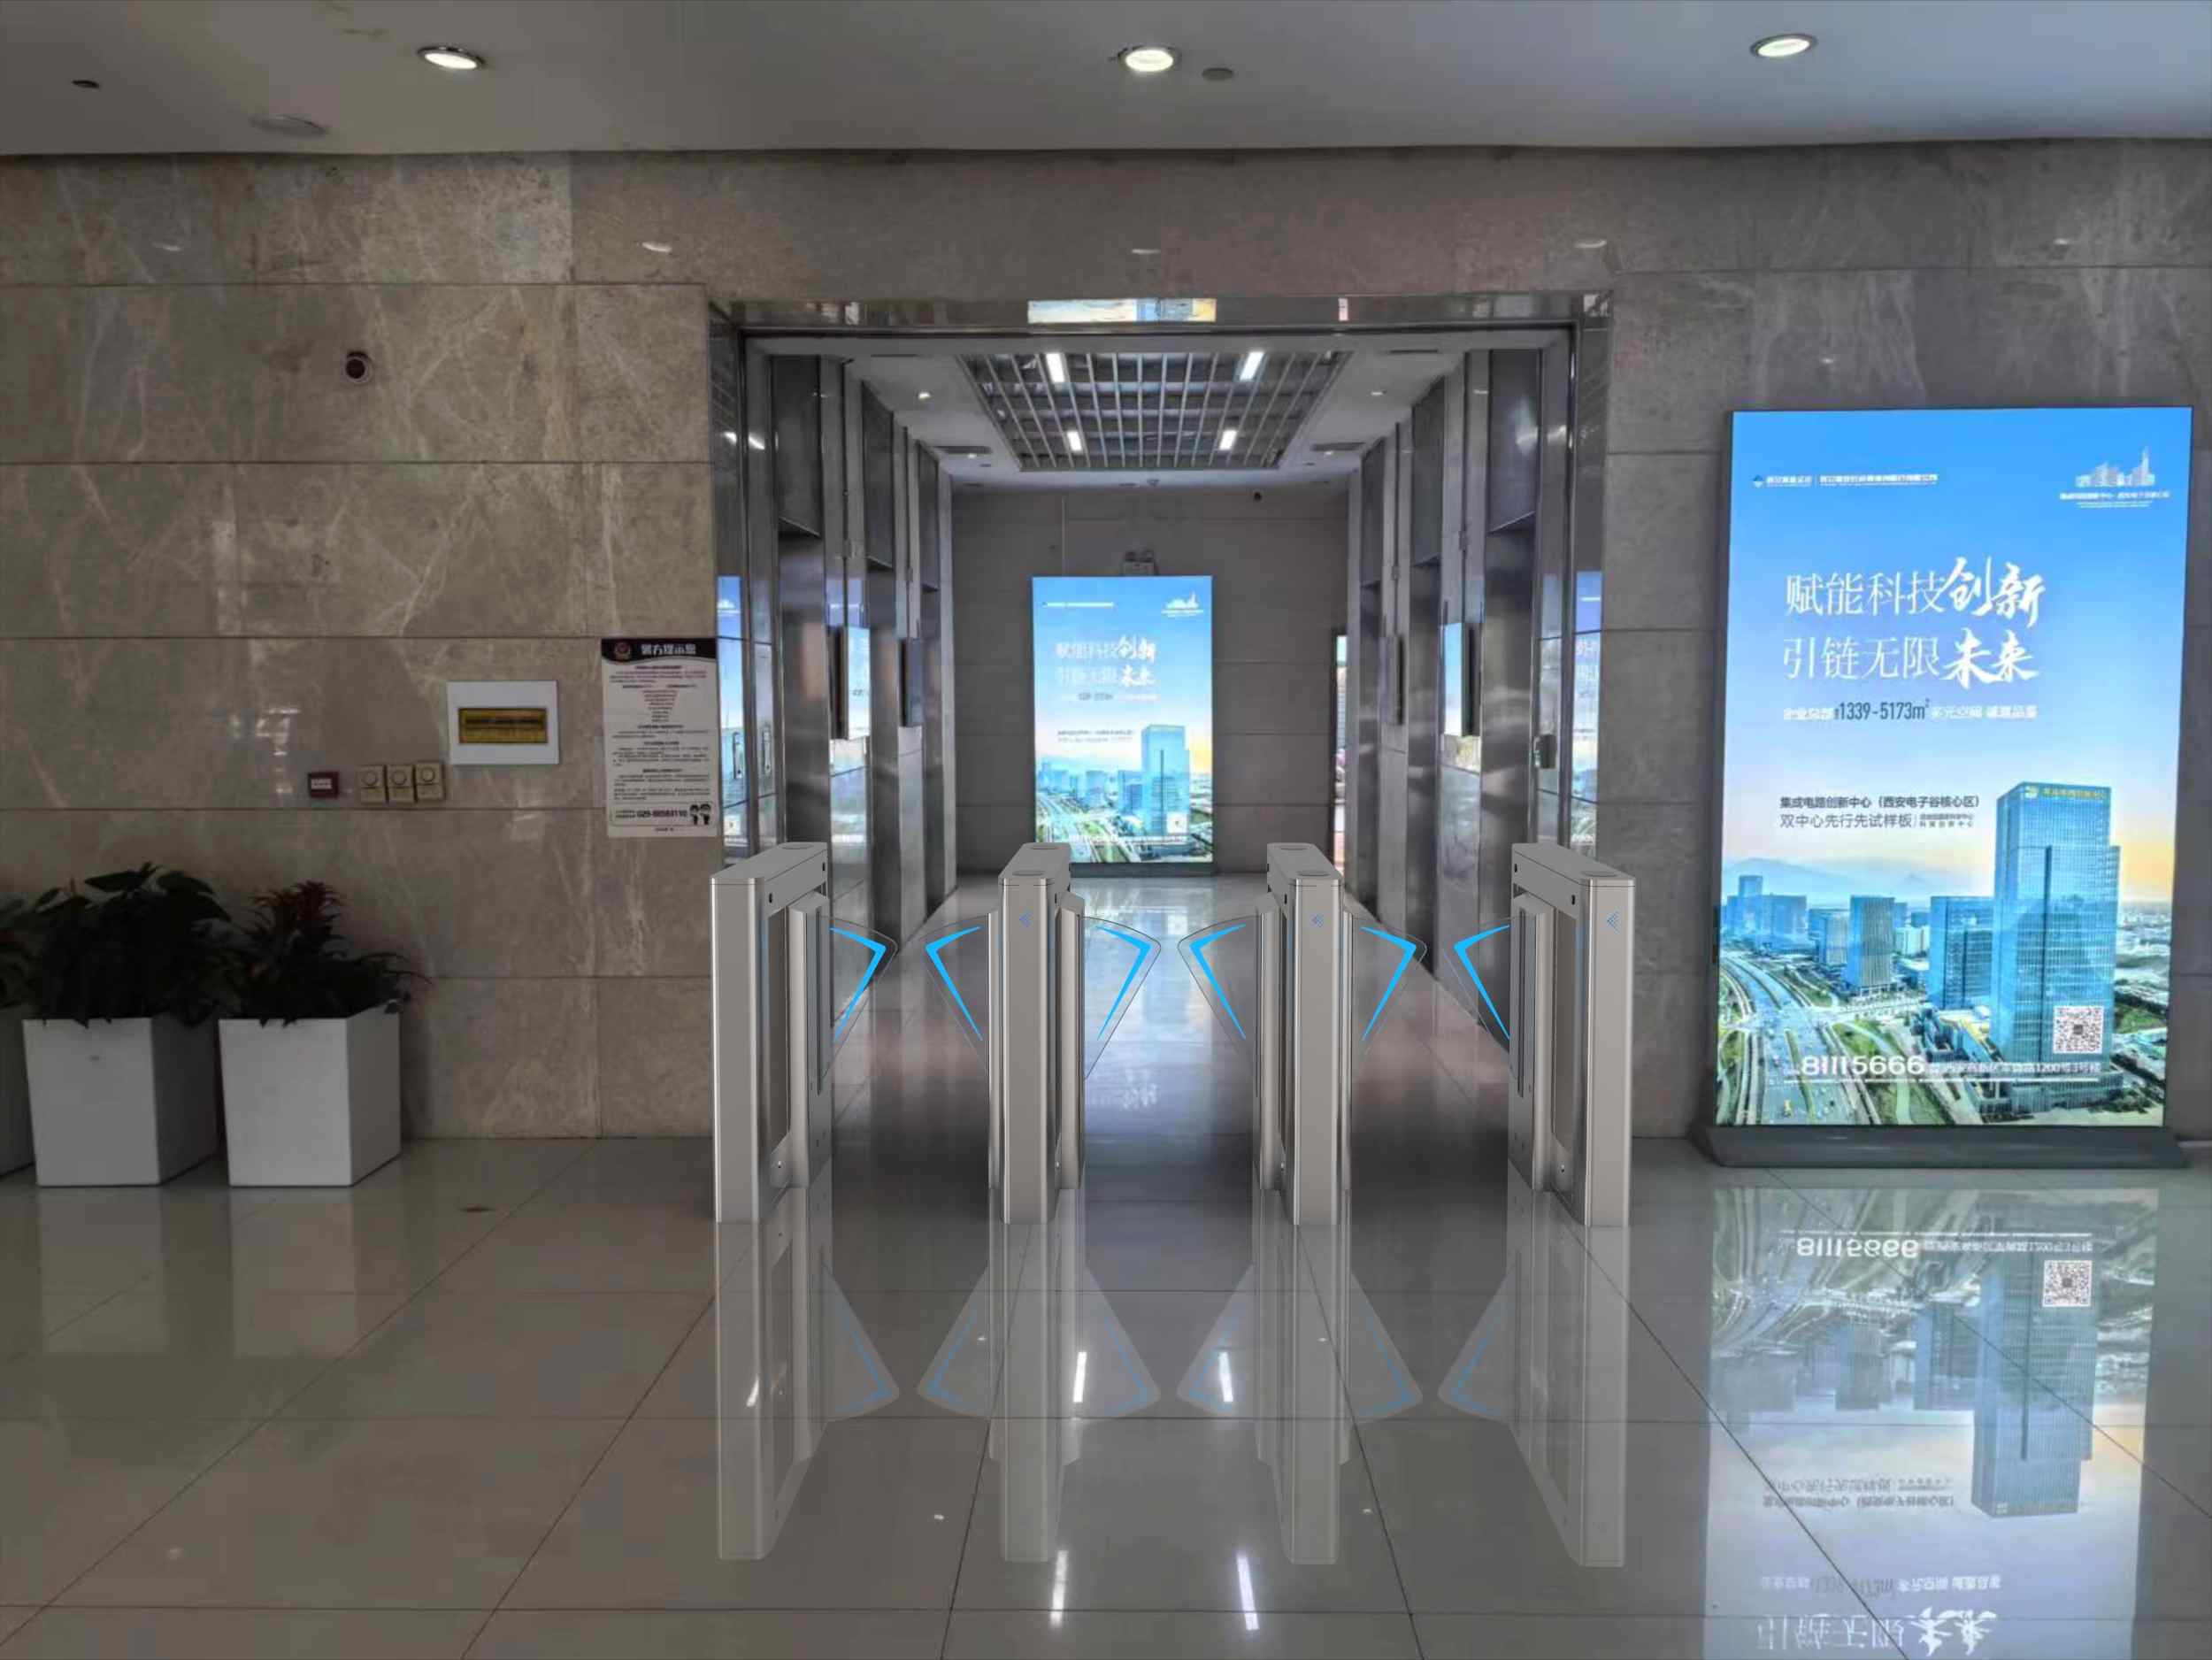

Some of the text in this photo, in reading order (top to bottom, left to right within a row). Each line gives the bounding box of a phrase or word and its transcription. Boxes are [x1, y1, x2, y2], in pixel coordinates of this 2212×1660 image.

[1786, 556, 2046, 628] 赋能科技创新
[1782, 627, 2040, 690] 引链无限未来
[1801, 1054, 1925, 1077] 81115666
